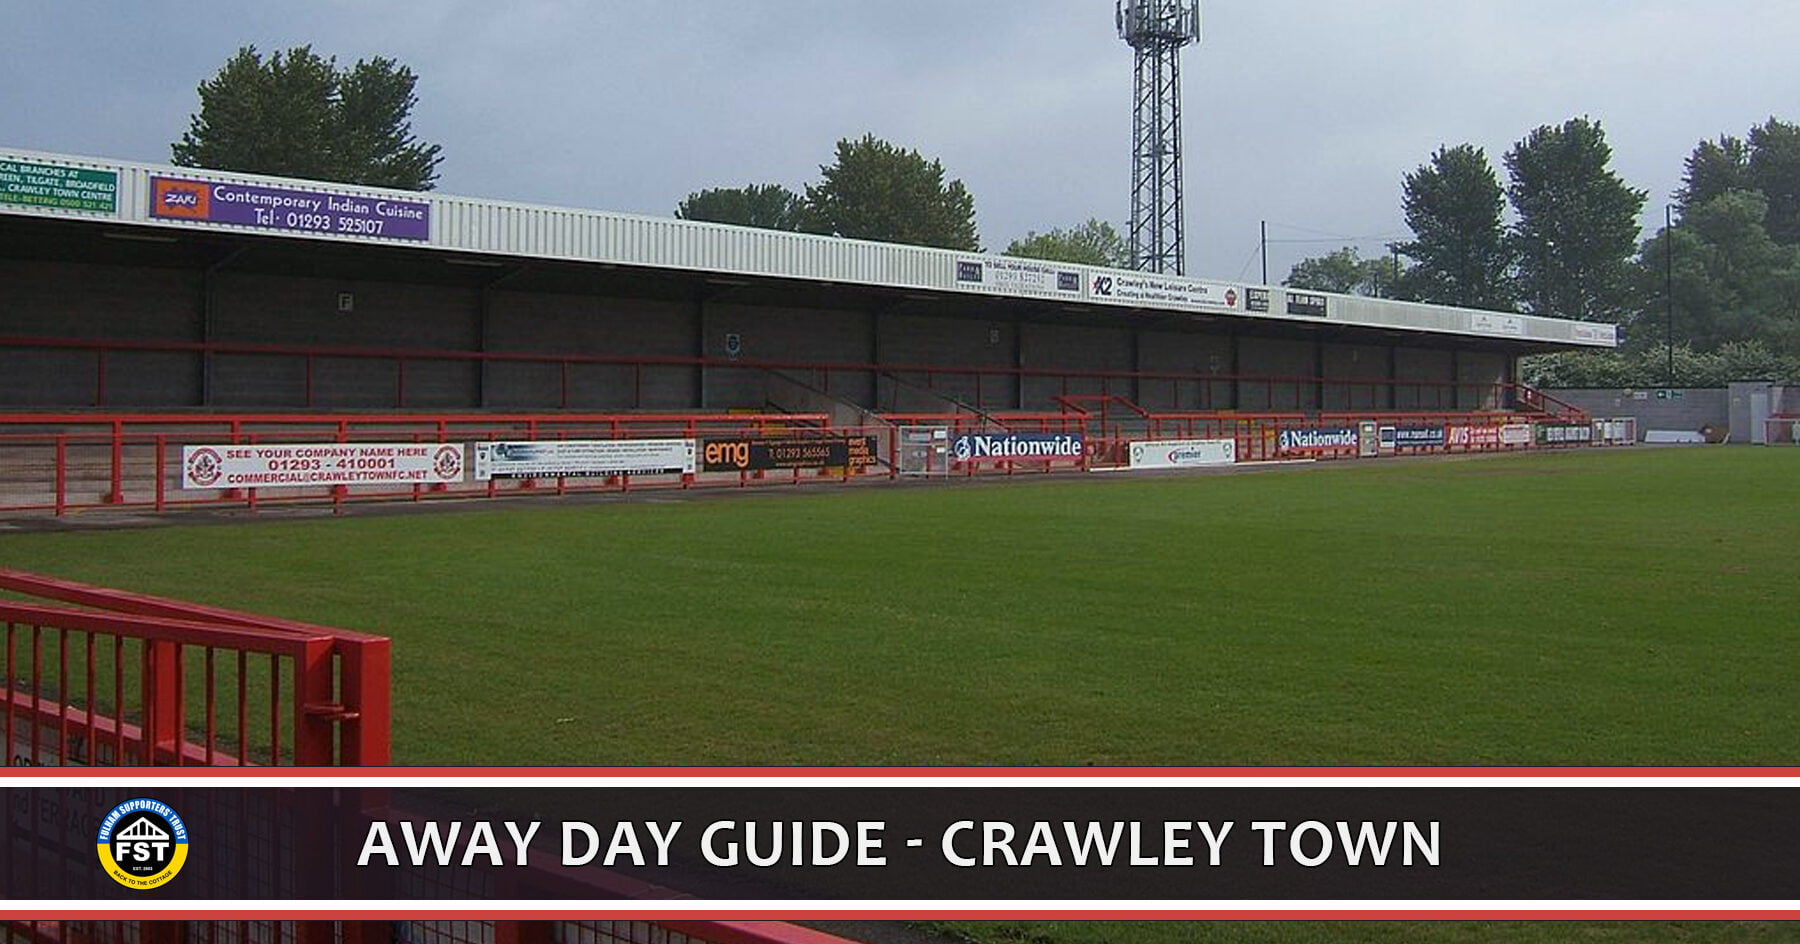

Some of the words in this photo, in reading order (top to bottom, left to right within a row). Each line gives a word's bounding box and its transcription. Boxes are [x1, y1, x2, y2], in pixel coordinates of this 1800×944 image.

[20, 164, 66, 177] BRANCHES
[68, 170, 79, 179] AT
[8, 183, 52, 196] CRAWLEY
[53, 188, 79, 198] TOWN
[80, 190, 112, 201] CENTRE
[65, 180, 115, 192] BROADFIELD
[213, 185, 321, 211] Contemporary
[328, 196, 369, 214] Indian
[375, 201, 423, 220] Cuisine
[287, 211, 331, 230] 01293
[338, 217, 384, 235] 525107
[1095, 276, 1113, 296] K2
[1117, 277, 1148, 290] Crawley's
[1150, 281, 1162, 290] New
[974, 435, 1081, 457] Nationwide
[1290, 429, 1358, 447] Nationwide
[226, 450, 251, 459] SEE
[256, 449, 292, 458] YOUR
[295, 448, 356, 458] COMPANY
[359, 447, 394, 457] NAME
[397, 447, 428, 457] HERE
[705, 441, 749, 468] emg
[848, 455, 876, 467] graphics
[268, 459, 321, 471] 01293
[336, 458, 395, 469] 410001
[227, 470, 428, 484] COMMERCIAL@CRAWLEYTOWNFC.NET
